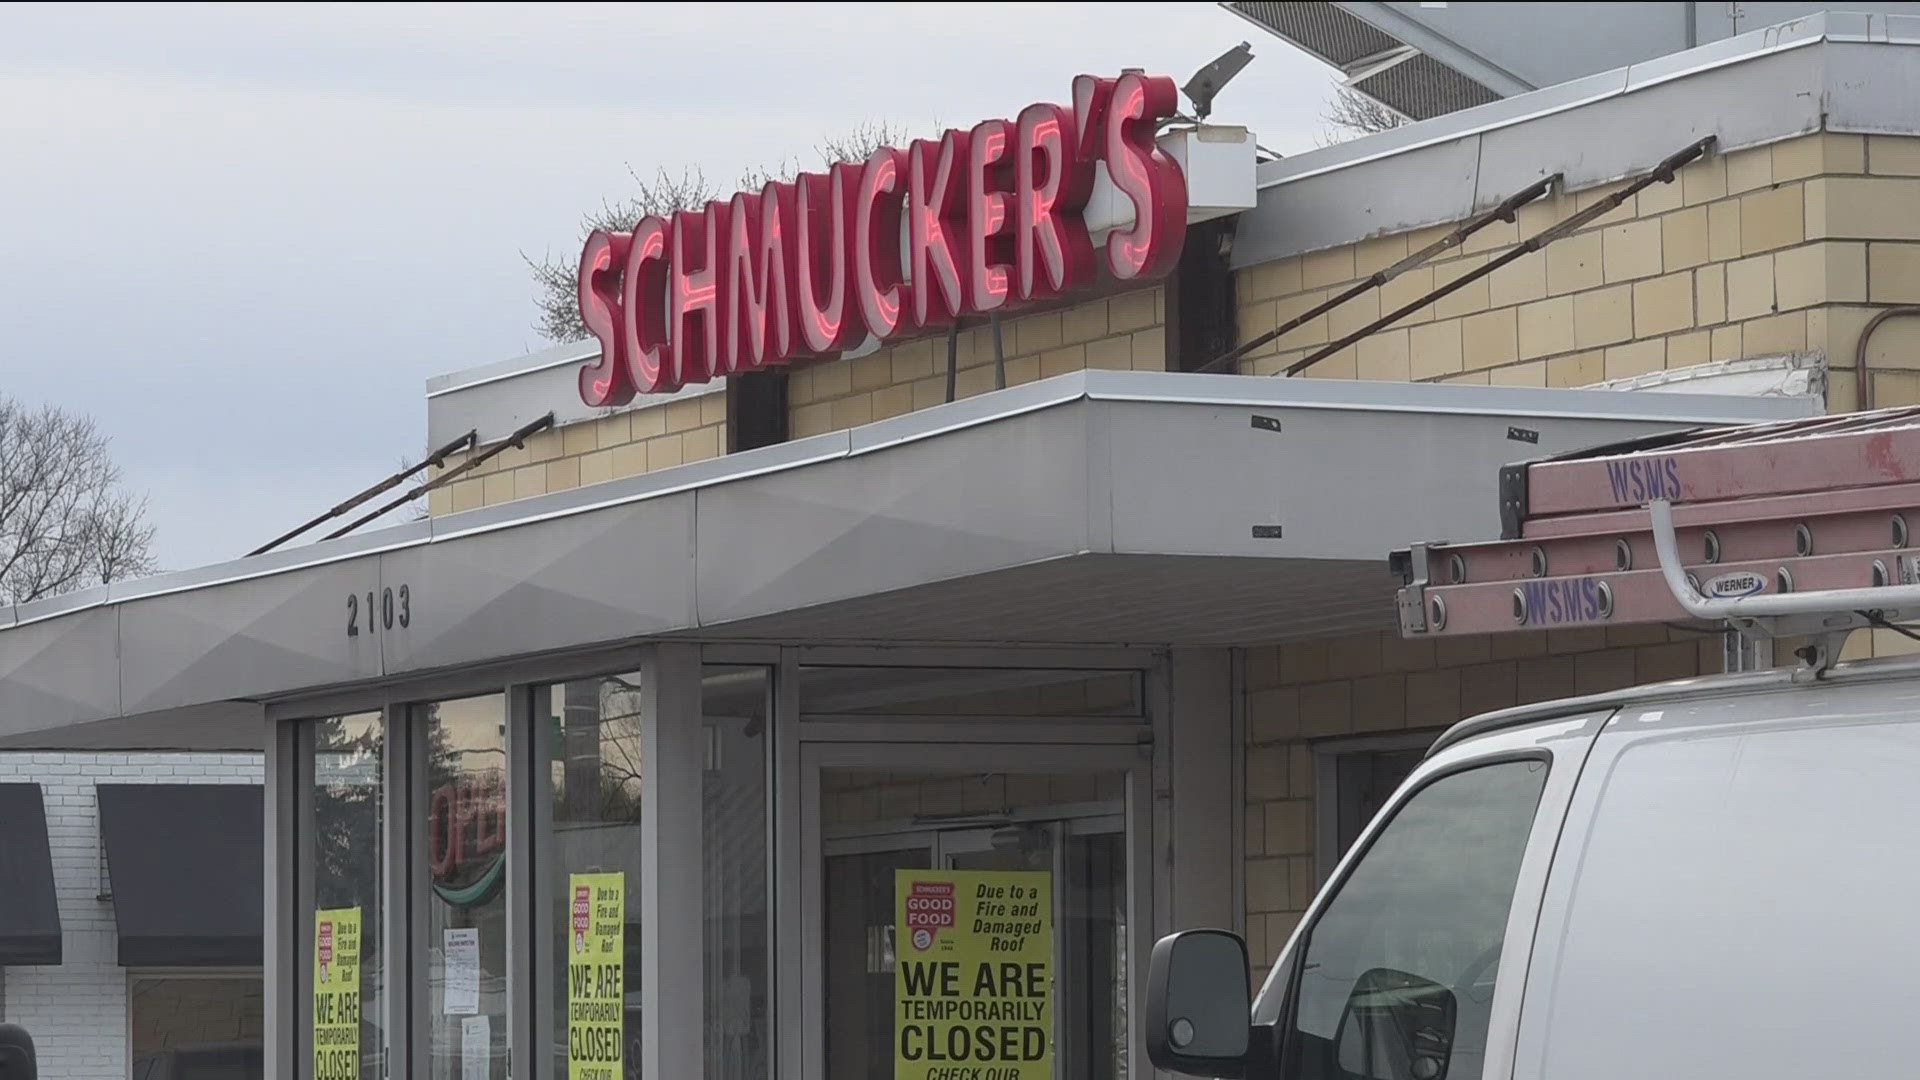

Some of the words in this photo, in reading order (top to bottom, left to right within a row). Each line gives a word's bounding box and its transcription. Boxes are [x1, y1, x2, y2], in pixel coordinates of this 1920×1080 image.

[578, 73, 1187, 407] SCHMUCKER'S
[1607, 457, 1681, 503] WSMS
[1715, 576, 1755, 594] WERNER
[1525, 577, 1600, 624] WSMS
[347, 584, 410, 637] 2103
[597, 886, 608, 901] Due
[976, 884, 1004, 899] Due
[1009, 884, 1024, 899] to
[1029, 888, 1038, 899] a
[573, 902, 589, 915] GOOD
[597, 903, 608, 918] Fire
[609, 904, 619, 918] and
[908, 898, 953, 911] GOOD
[976, 901, 1006, 917] Fire
[1011, 902, 1038, 917] and
[574, 916, 589, 928] FOOD
[908, 913, 952, 925] FOOD
[973, 918, 1042, 938] Damaged
[595, 921, 620, 939] Damaged
[990, 936, 1025, 952] Roof
[571, 964, 592, 999] WE
[595, 964, 620, 999] ARE
[901, 961, 960, 997] WE
[972, 962, 1046, 998] ARE
[316, 992, 334, 1025] WE
[337, 991, 358, 1024] ARE
[571, 1002, 620, 1022] TEMPORARILY
[901, 1000, 1046, 1021] TEMPORARILY
[315, 1027, 357, 1046] TEMPORARILY
[570, 1026, 621, 1062] CLOSED
[901, 1024, 1046, 1061] CLOSED
[315, 1050, 358, 1080] CLOSED
[926, 1067, 982, 1080] CHECK
[985, 1067, 1020, 1080] OUR
